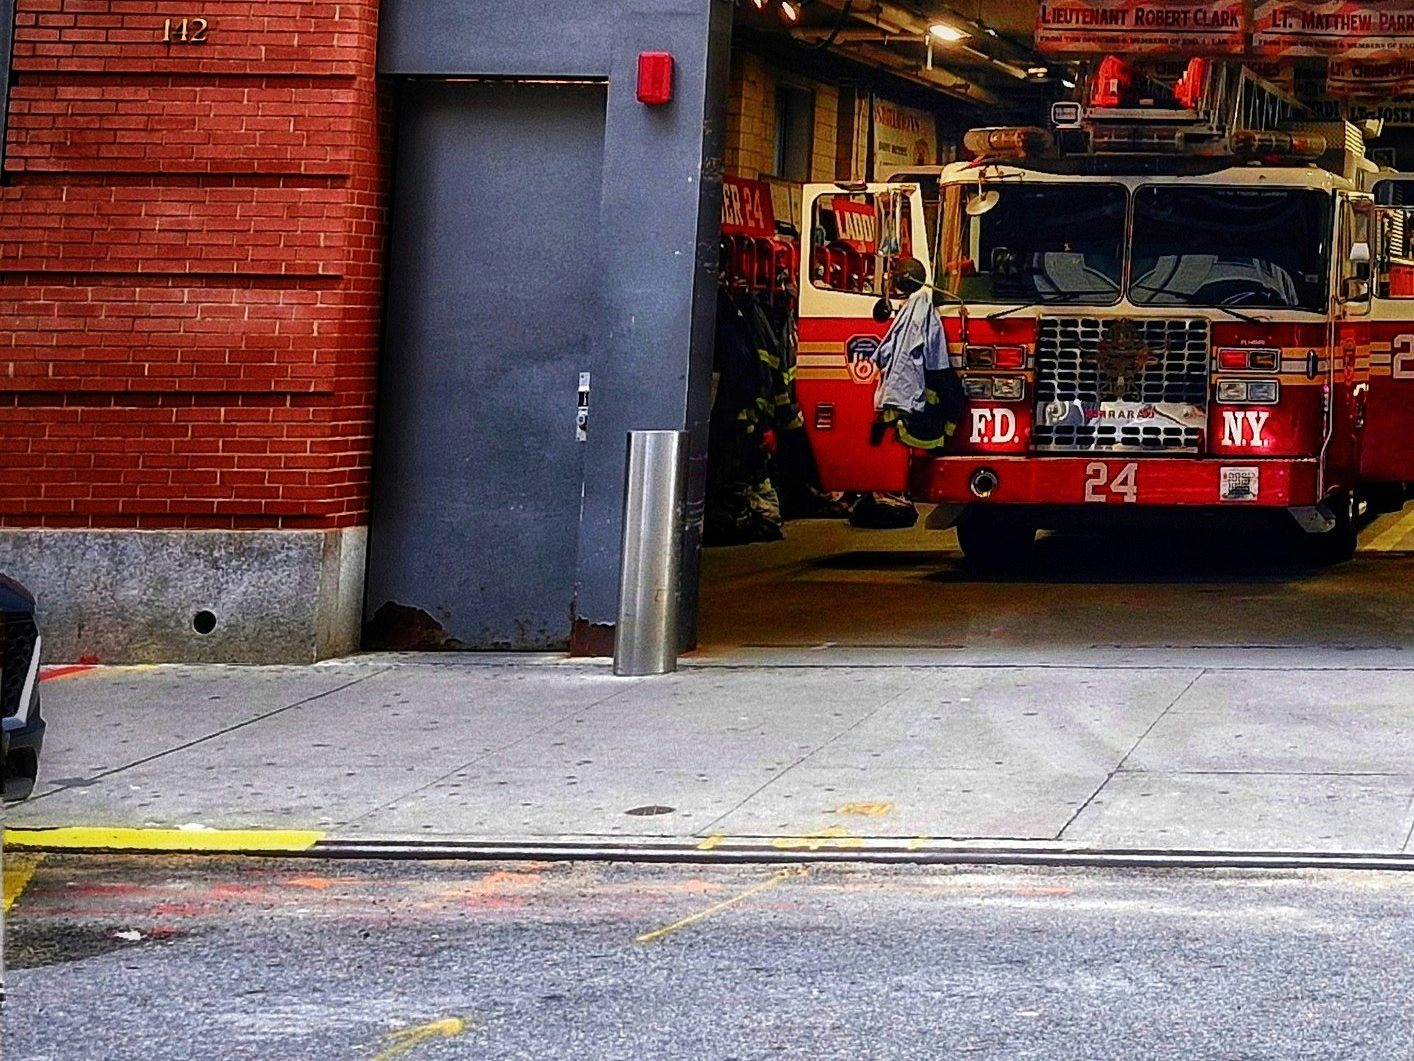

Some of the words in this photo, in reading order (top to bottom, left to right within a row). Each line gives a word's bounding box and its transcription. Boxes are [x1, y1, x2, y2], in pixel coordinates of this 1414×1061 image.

[1041, 5, 1130, 26] LIEUTENANT
[1134, 7, 1190, 26] ROBERT
[1192, 8, 1239, 27] CLARK
[1272, 9, 1293, 28] LT.
[1302, 10, 1372, 31] MATTHEW
[162, 18, 208, 42] 142
[969, 408, 1020, 444] F.D.
[1221, 410, 1270, 447] N.Y.
[1084, 462, 1139, 503] 24
